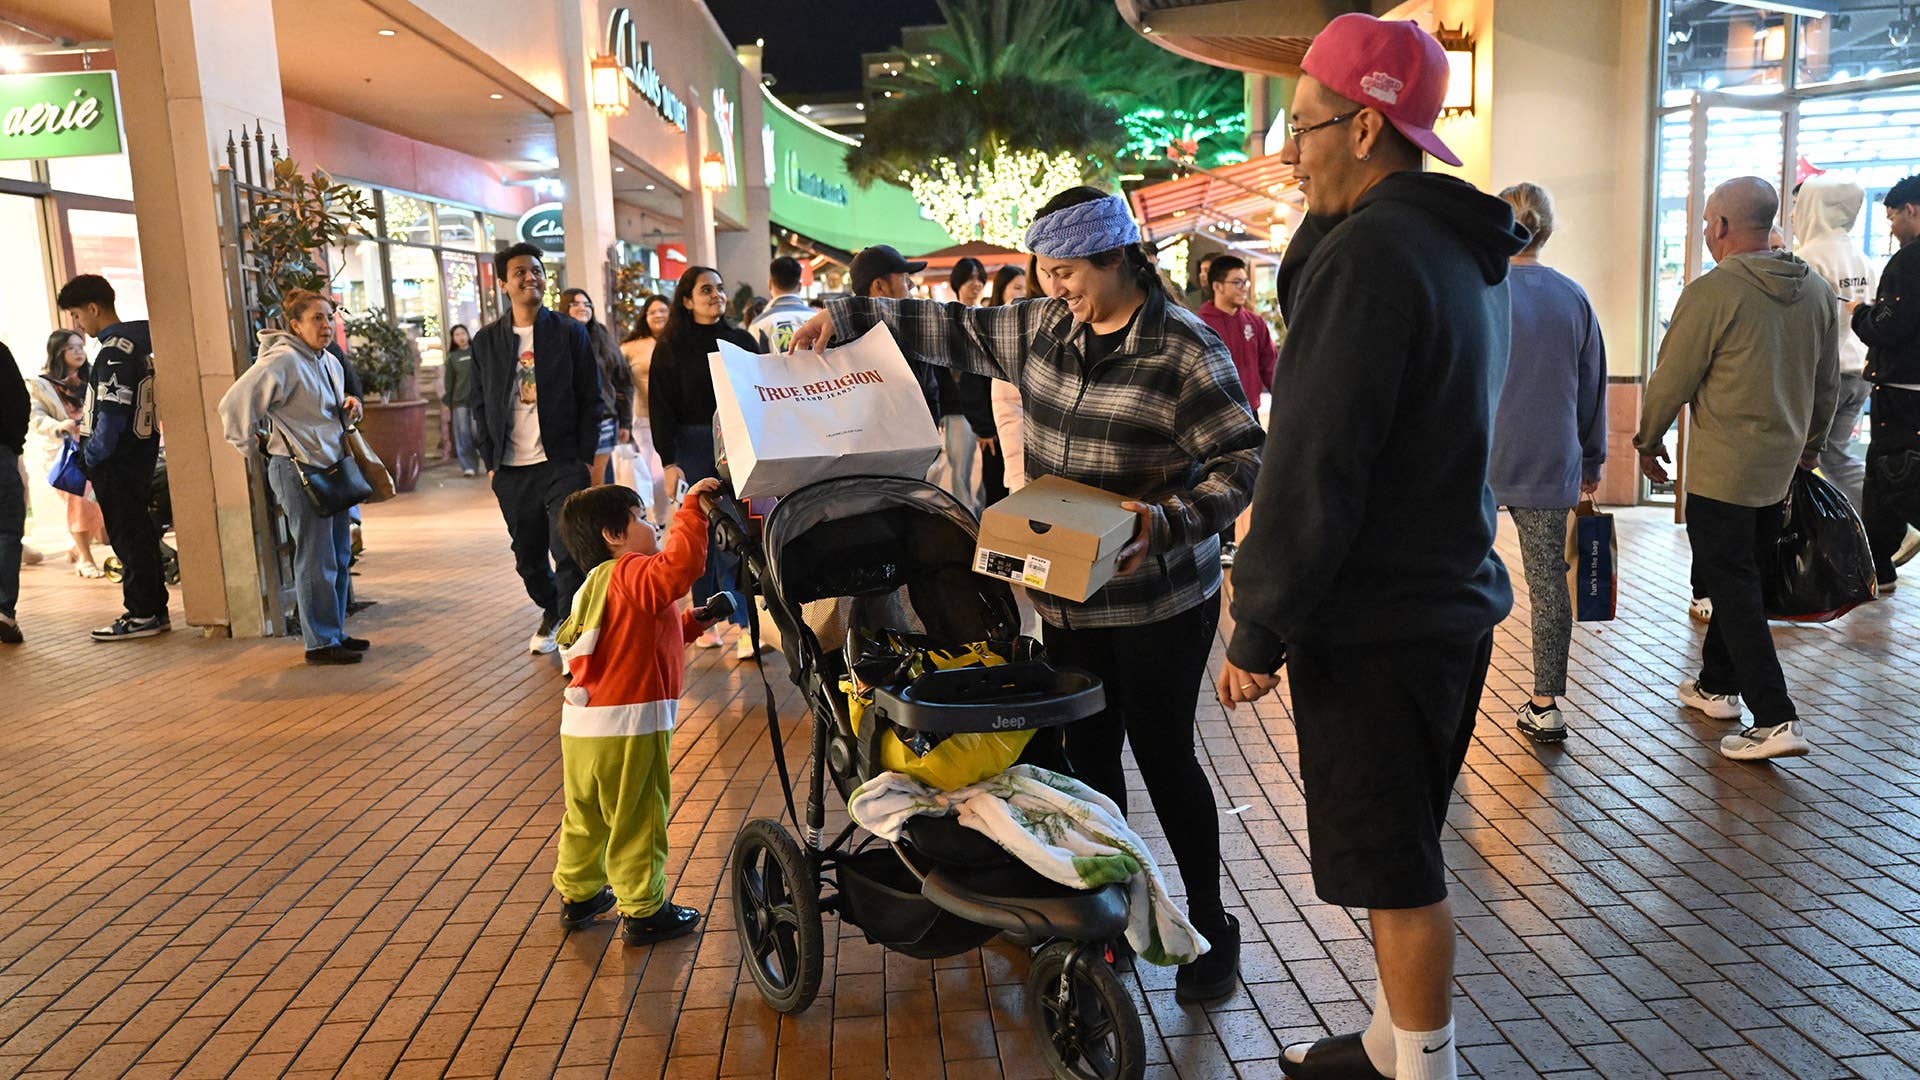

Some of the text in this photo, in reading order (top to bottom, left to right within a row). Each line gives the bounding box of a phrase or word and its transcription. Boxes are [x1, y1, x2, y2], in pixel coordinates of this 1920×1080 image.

[3, 88, 99, 136] aerie
[754, 370, 884, 402] TRUE RELIGION
[991, 715, 1026, 729] Jeep
